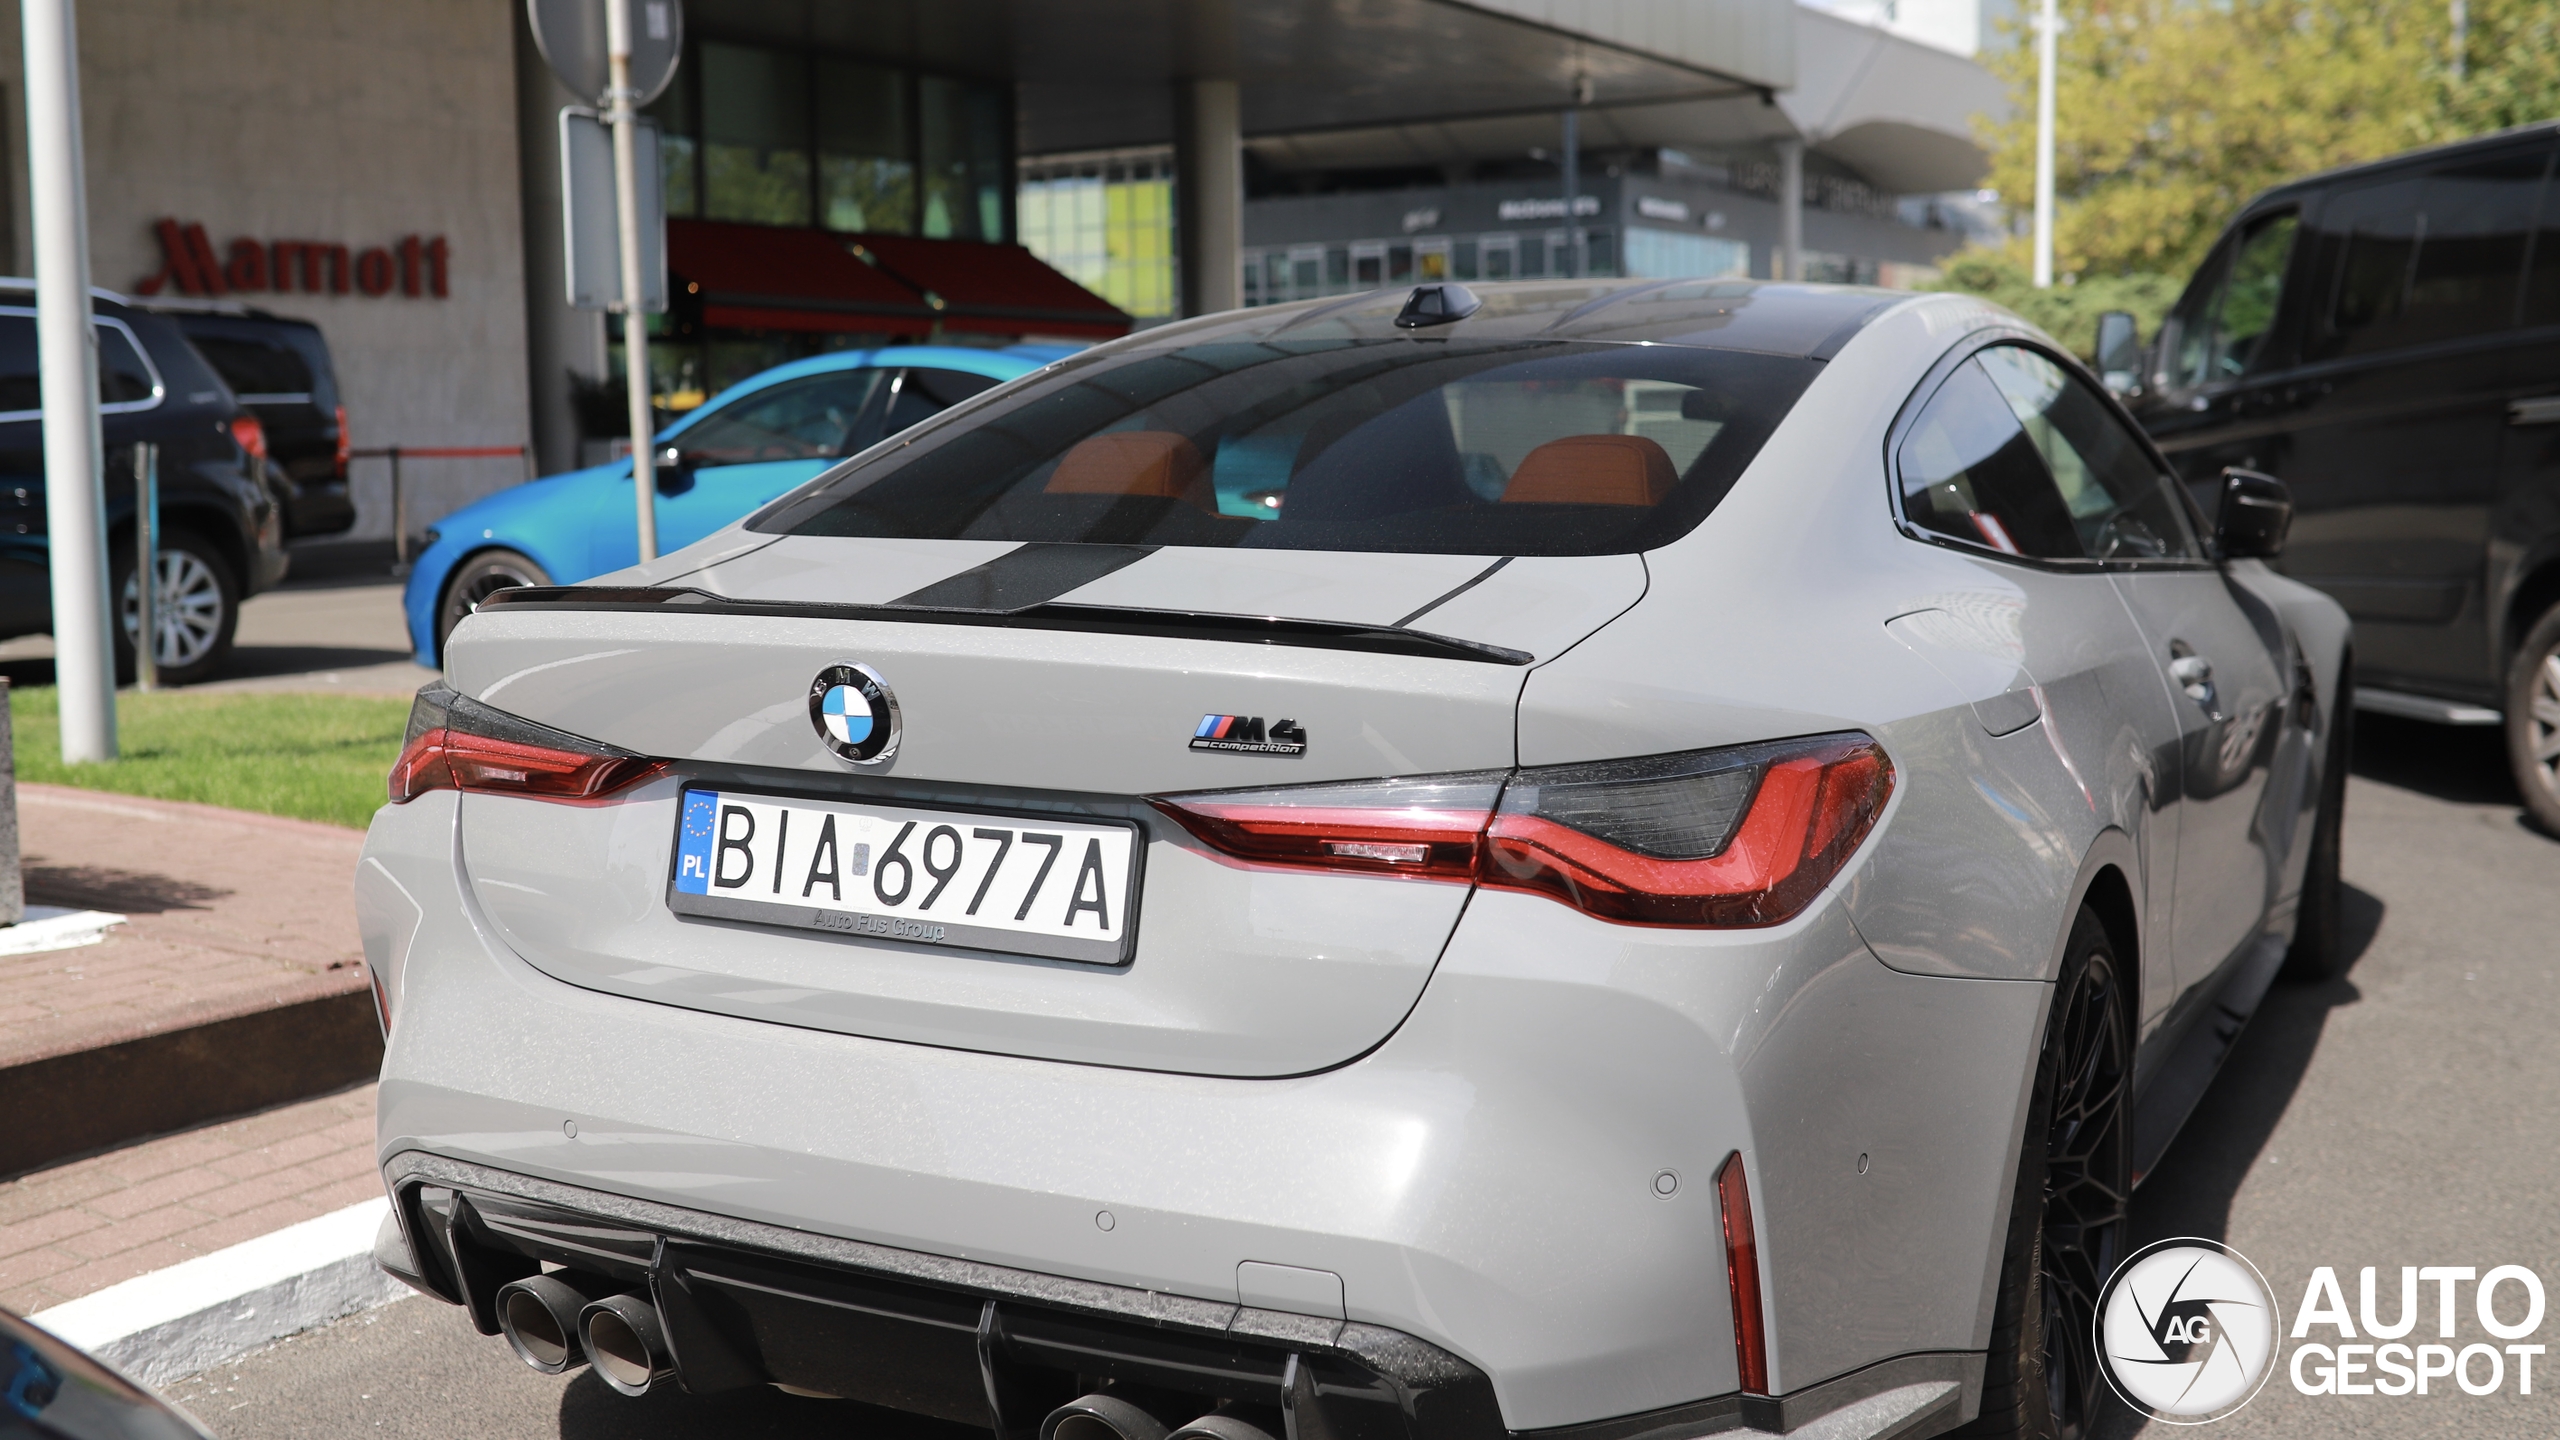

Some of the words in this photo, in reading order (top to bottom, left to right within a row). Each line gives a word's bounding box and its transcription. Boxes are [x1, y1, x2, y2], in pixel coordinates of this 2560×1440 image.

[135, 217, 451, 299] Marriott
[813, 667, 880, 701] BMW
[1226, 715, 1307, 743] M4
[1209, 741, 1300, 754] competition
[682, 854, 705, 878] PL
[714, 804, 841, 901] BIA
[873, 821, 1109, 930] 6977A
[812, 909, 853, 930] Auto
[856, 913, 888, 934] Fus
[891, 917, 945, 943] Group
